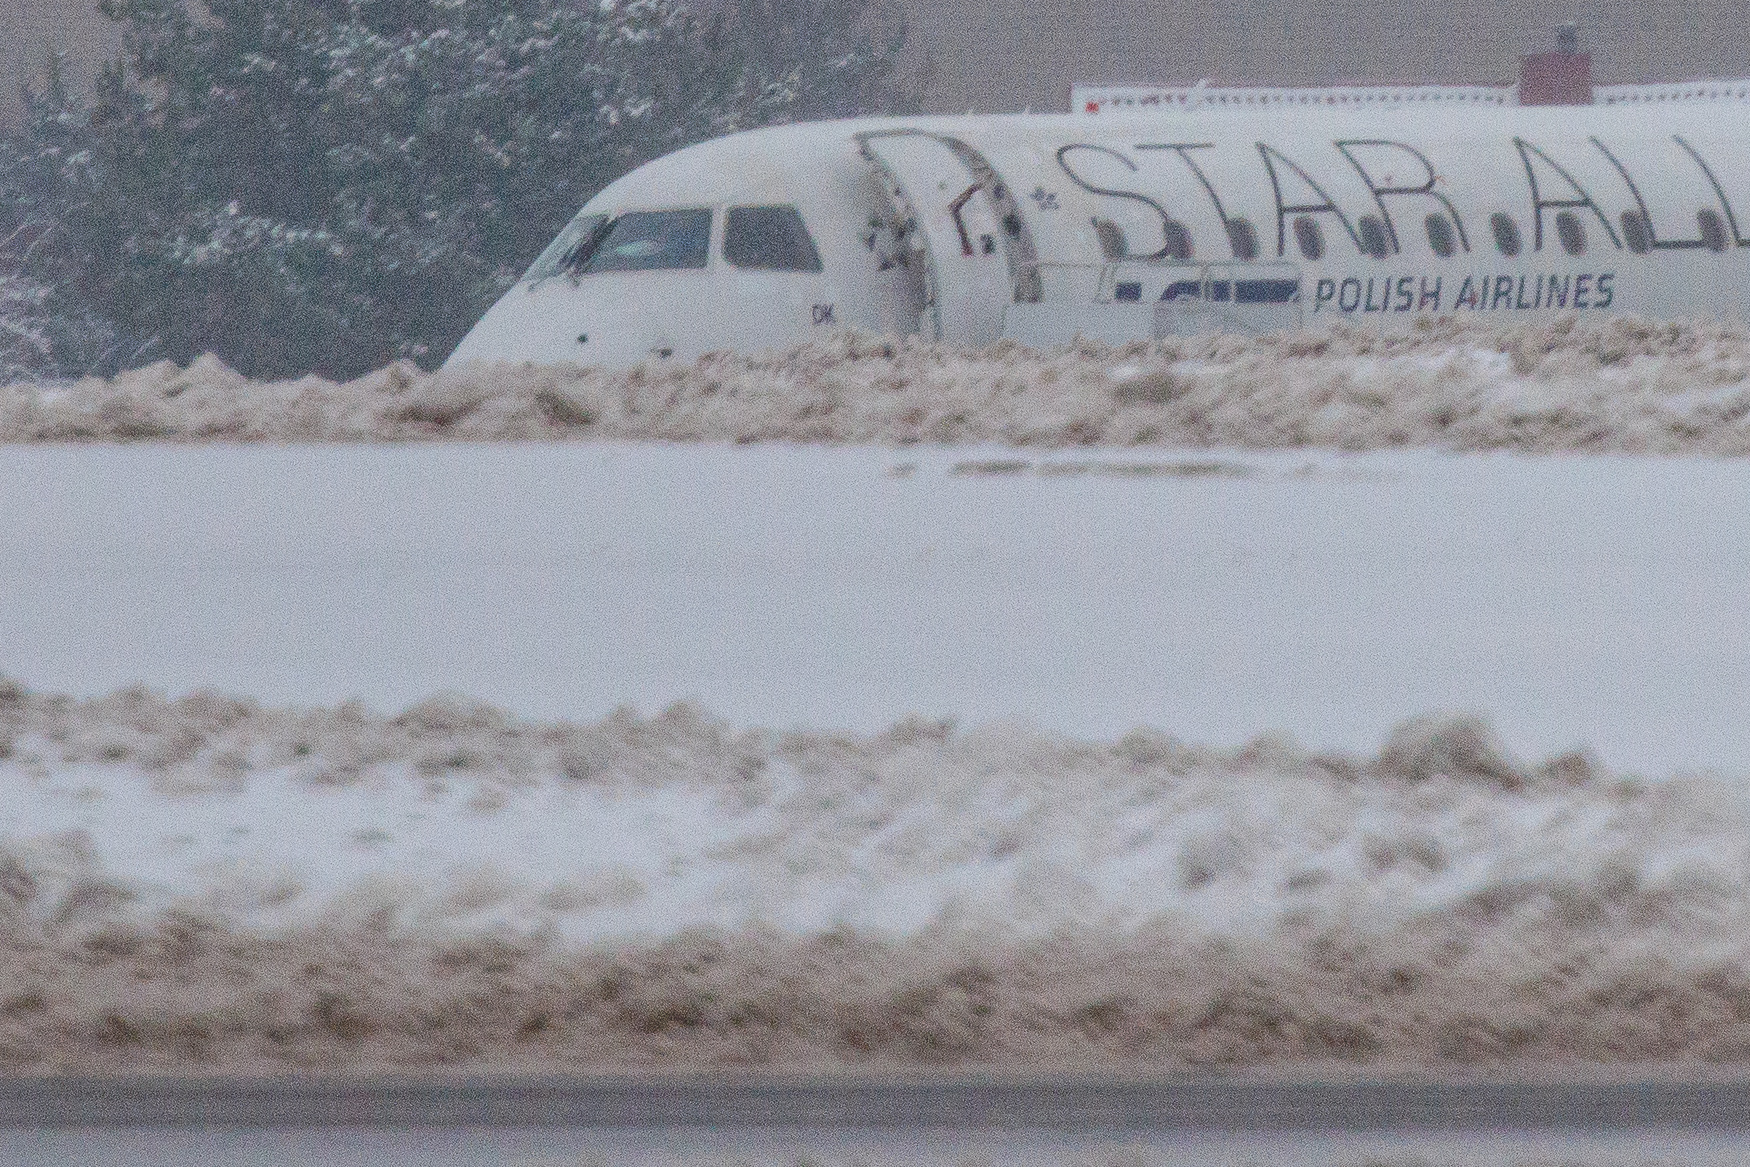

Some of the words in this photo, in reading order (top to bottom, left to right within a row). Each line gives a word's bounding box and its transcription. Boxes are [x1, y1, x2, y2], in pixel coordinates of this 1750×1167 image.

[1057, 139, 1469, 260] STAR
[812, 303, 837, 325] DK
[1314, 275, 1442, 314] POLISH
[1455, 273, 1616, 311] AIRLINES
